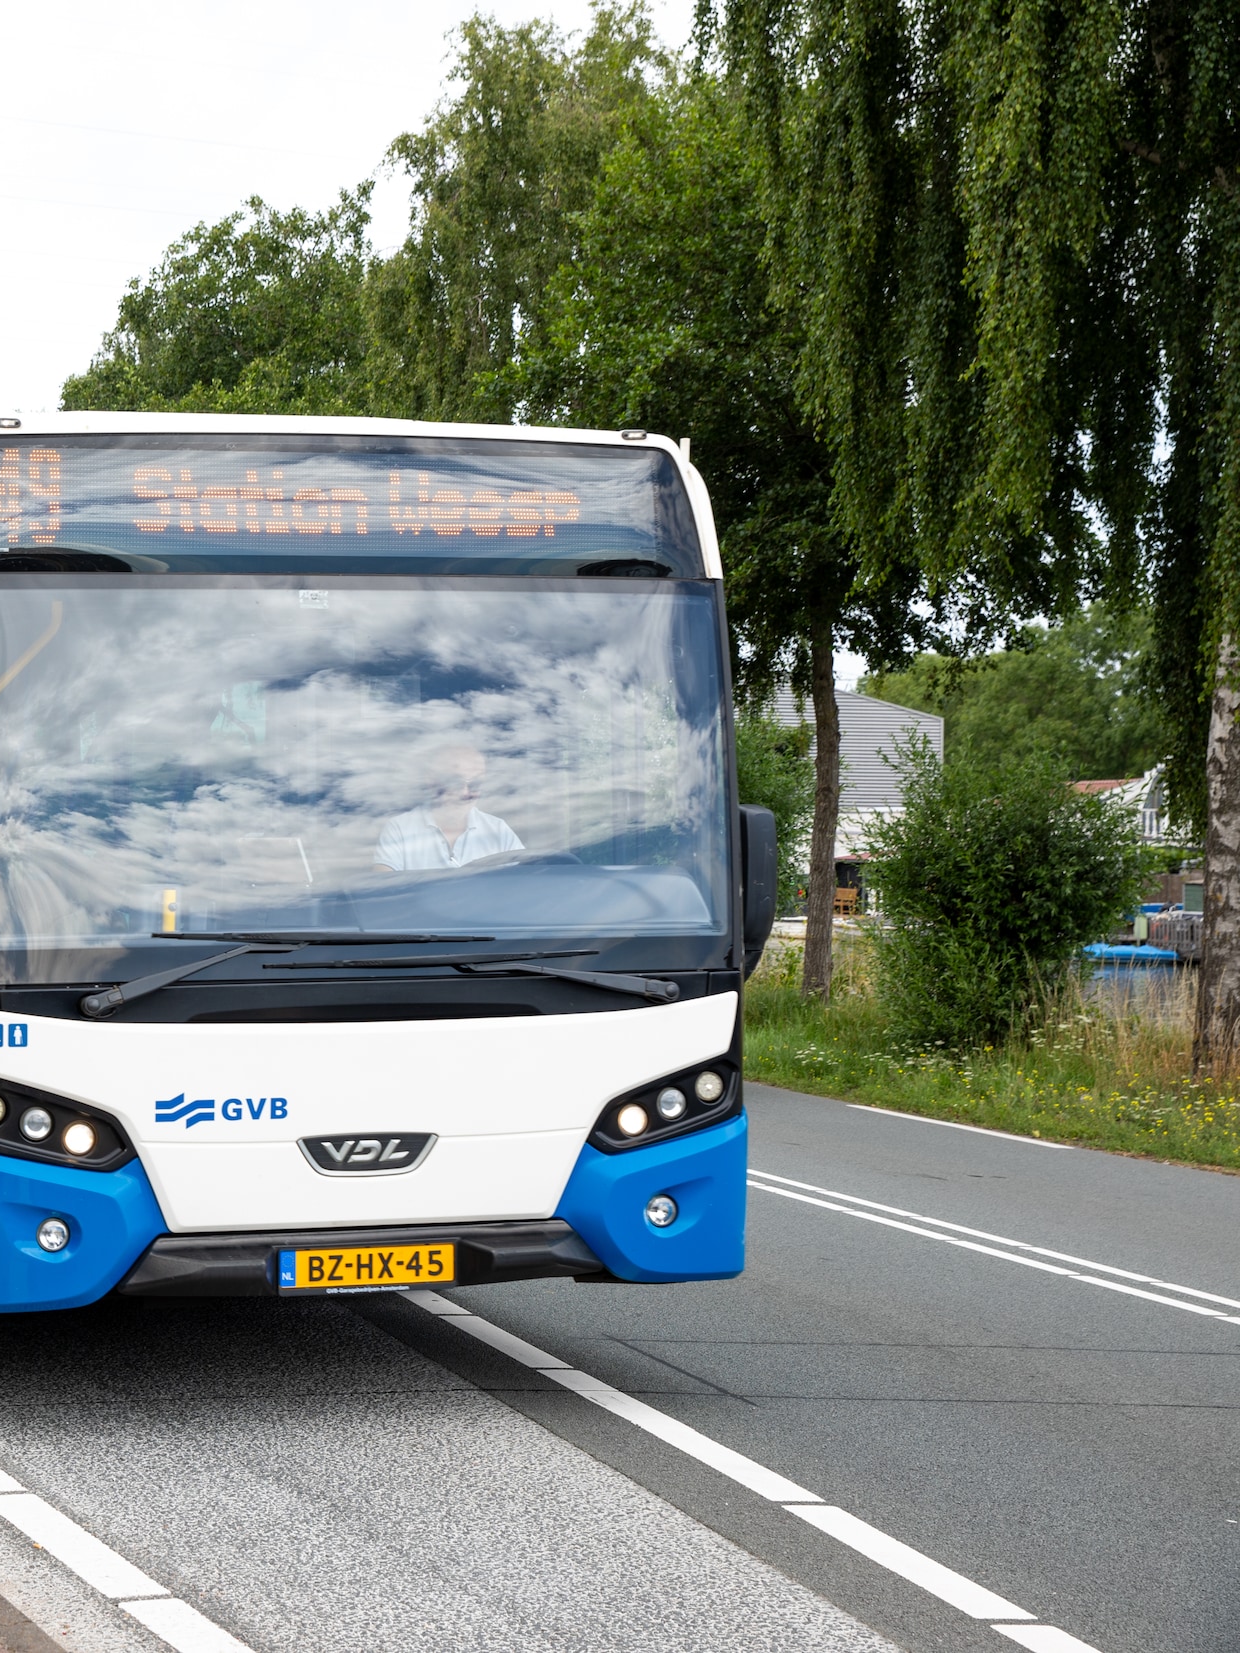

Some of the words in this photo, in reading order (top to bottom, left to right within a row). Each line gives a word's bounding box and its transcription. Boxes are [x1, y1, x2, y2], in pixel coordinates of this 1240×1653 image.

[133, 468, 368, 534] Station
[389, 473, 581, 537] Weesp
[221, 1097, 289, 1121] GVB
[321, 1139, 410, 1163] VDL
[282, 1272, 294, 1281] NL
[308, 1250, 444, 1282] BZ-HX-45
